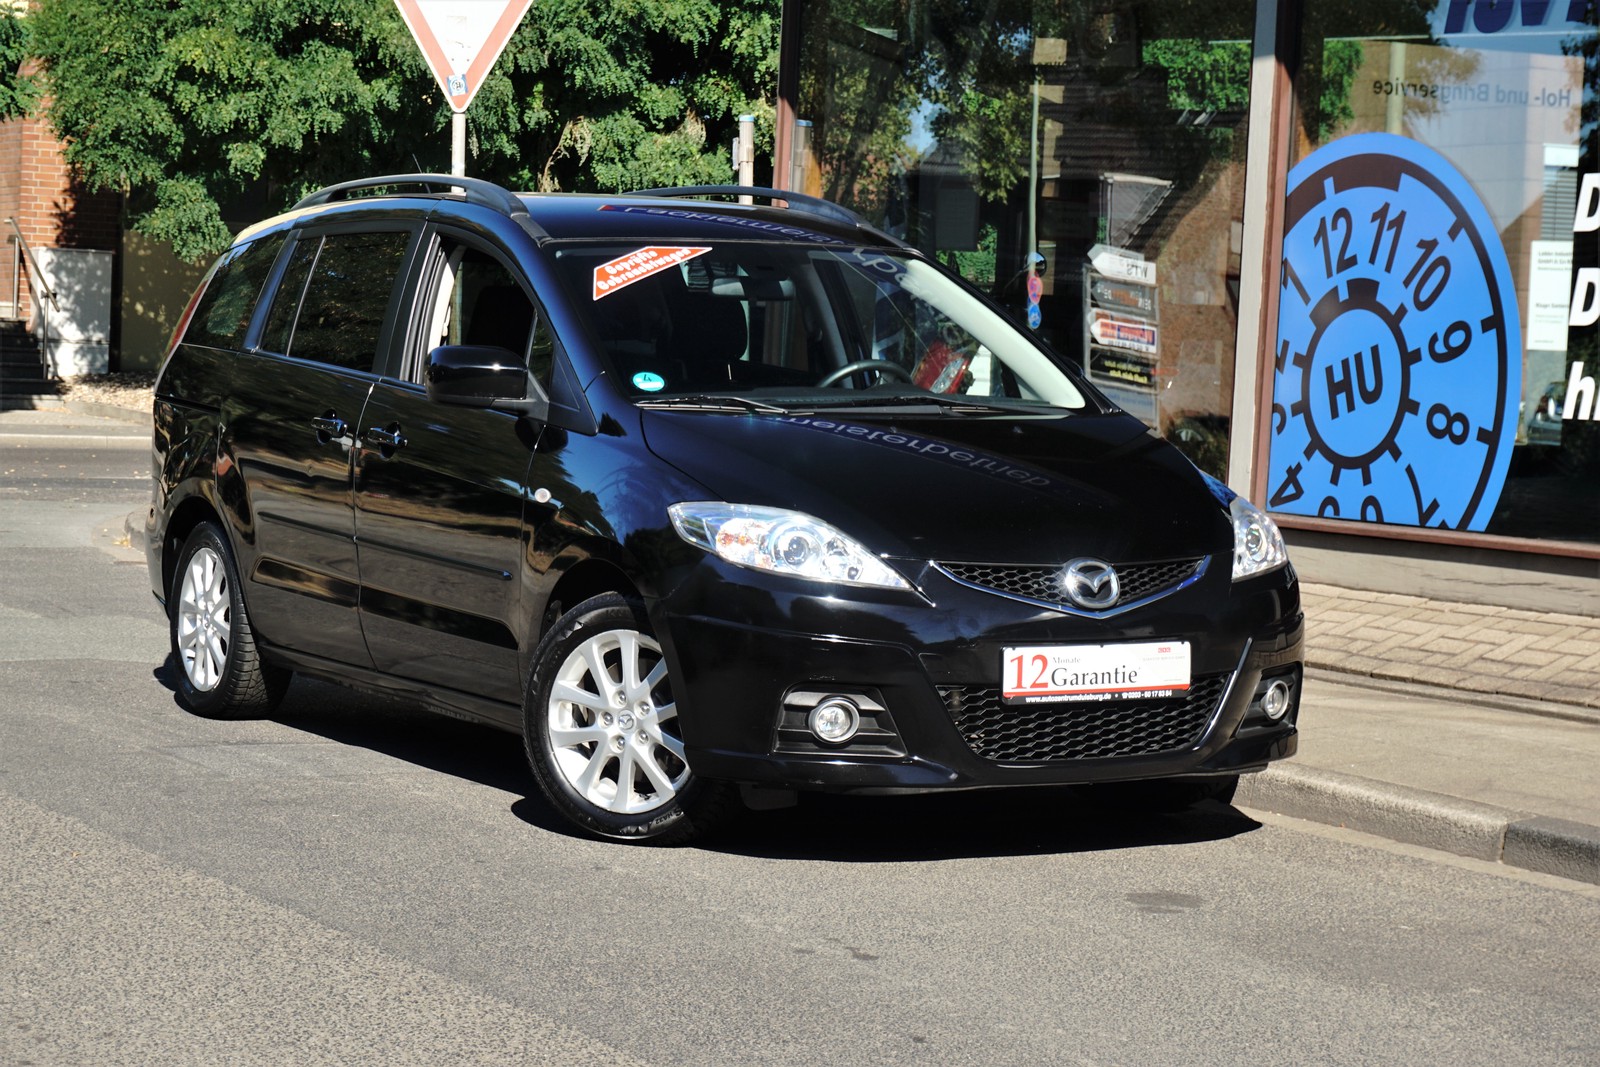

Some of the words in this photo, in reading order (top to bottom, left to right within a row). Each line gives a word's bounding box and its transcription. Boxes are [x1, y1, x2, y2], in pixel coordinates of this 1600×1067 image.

[1313, 206, 1358, 279] 12
[1368, 201, 1408, 274] 11
[597, 249, 692, 290] Gebrauchtwagen
[604, 250, 658, 275] Geprüfte
[1403, 238, 1452, 312] 10
[1428, 320, 1473, 364] 9
[1325, 344, 1384, 420] HU
[1426, 403, 1471, 446] 8
[1269, 462, 1305, 508] 4
[1010, 654, 1049, 690] 12
[1051, 665, 1138, 687] Garantie
